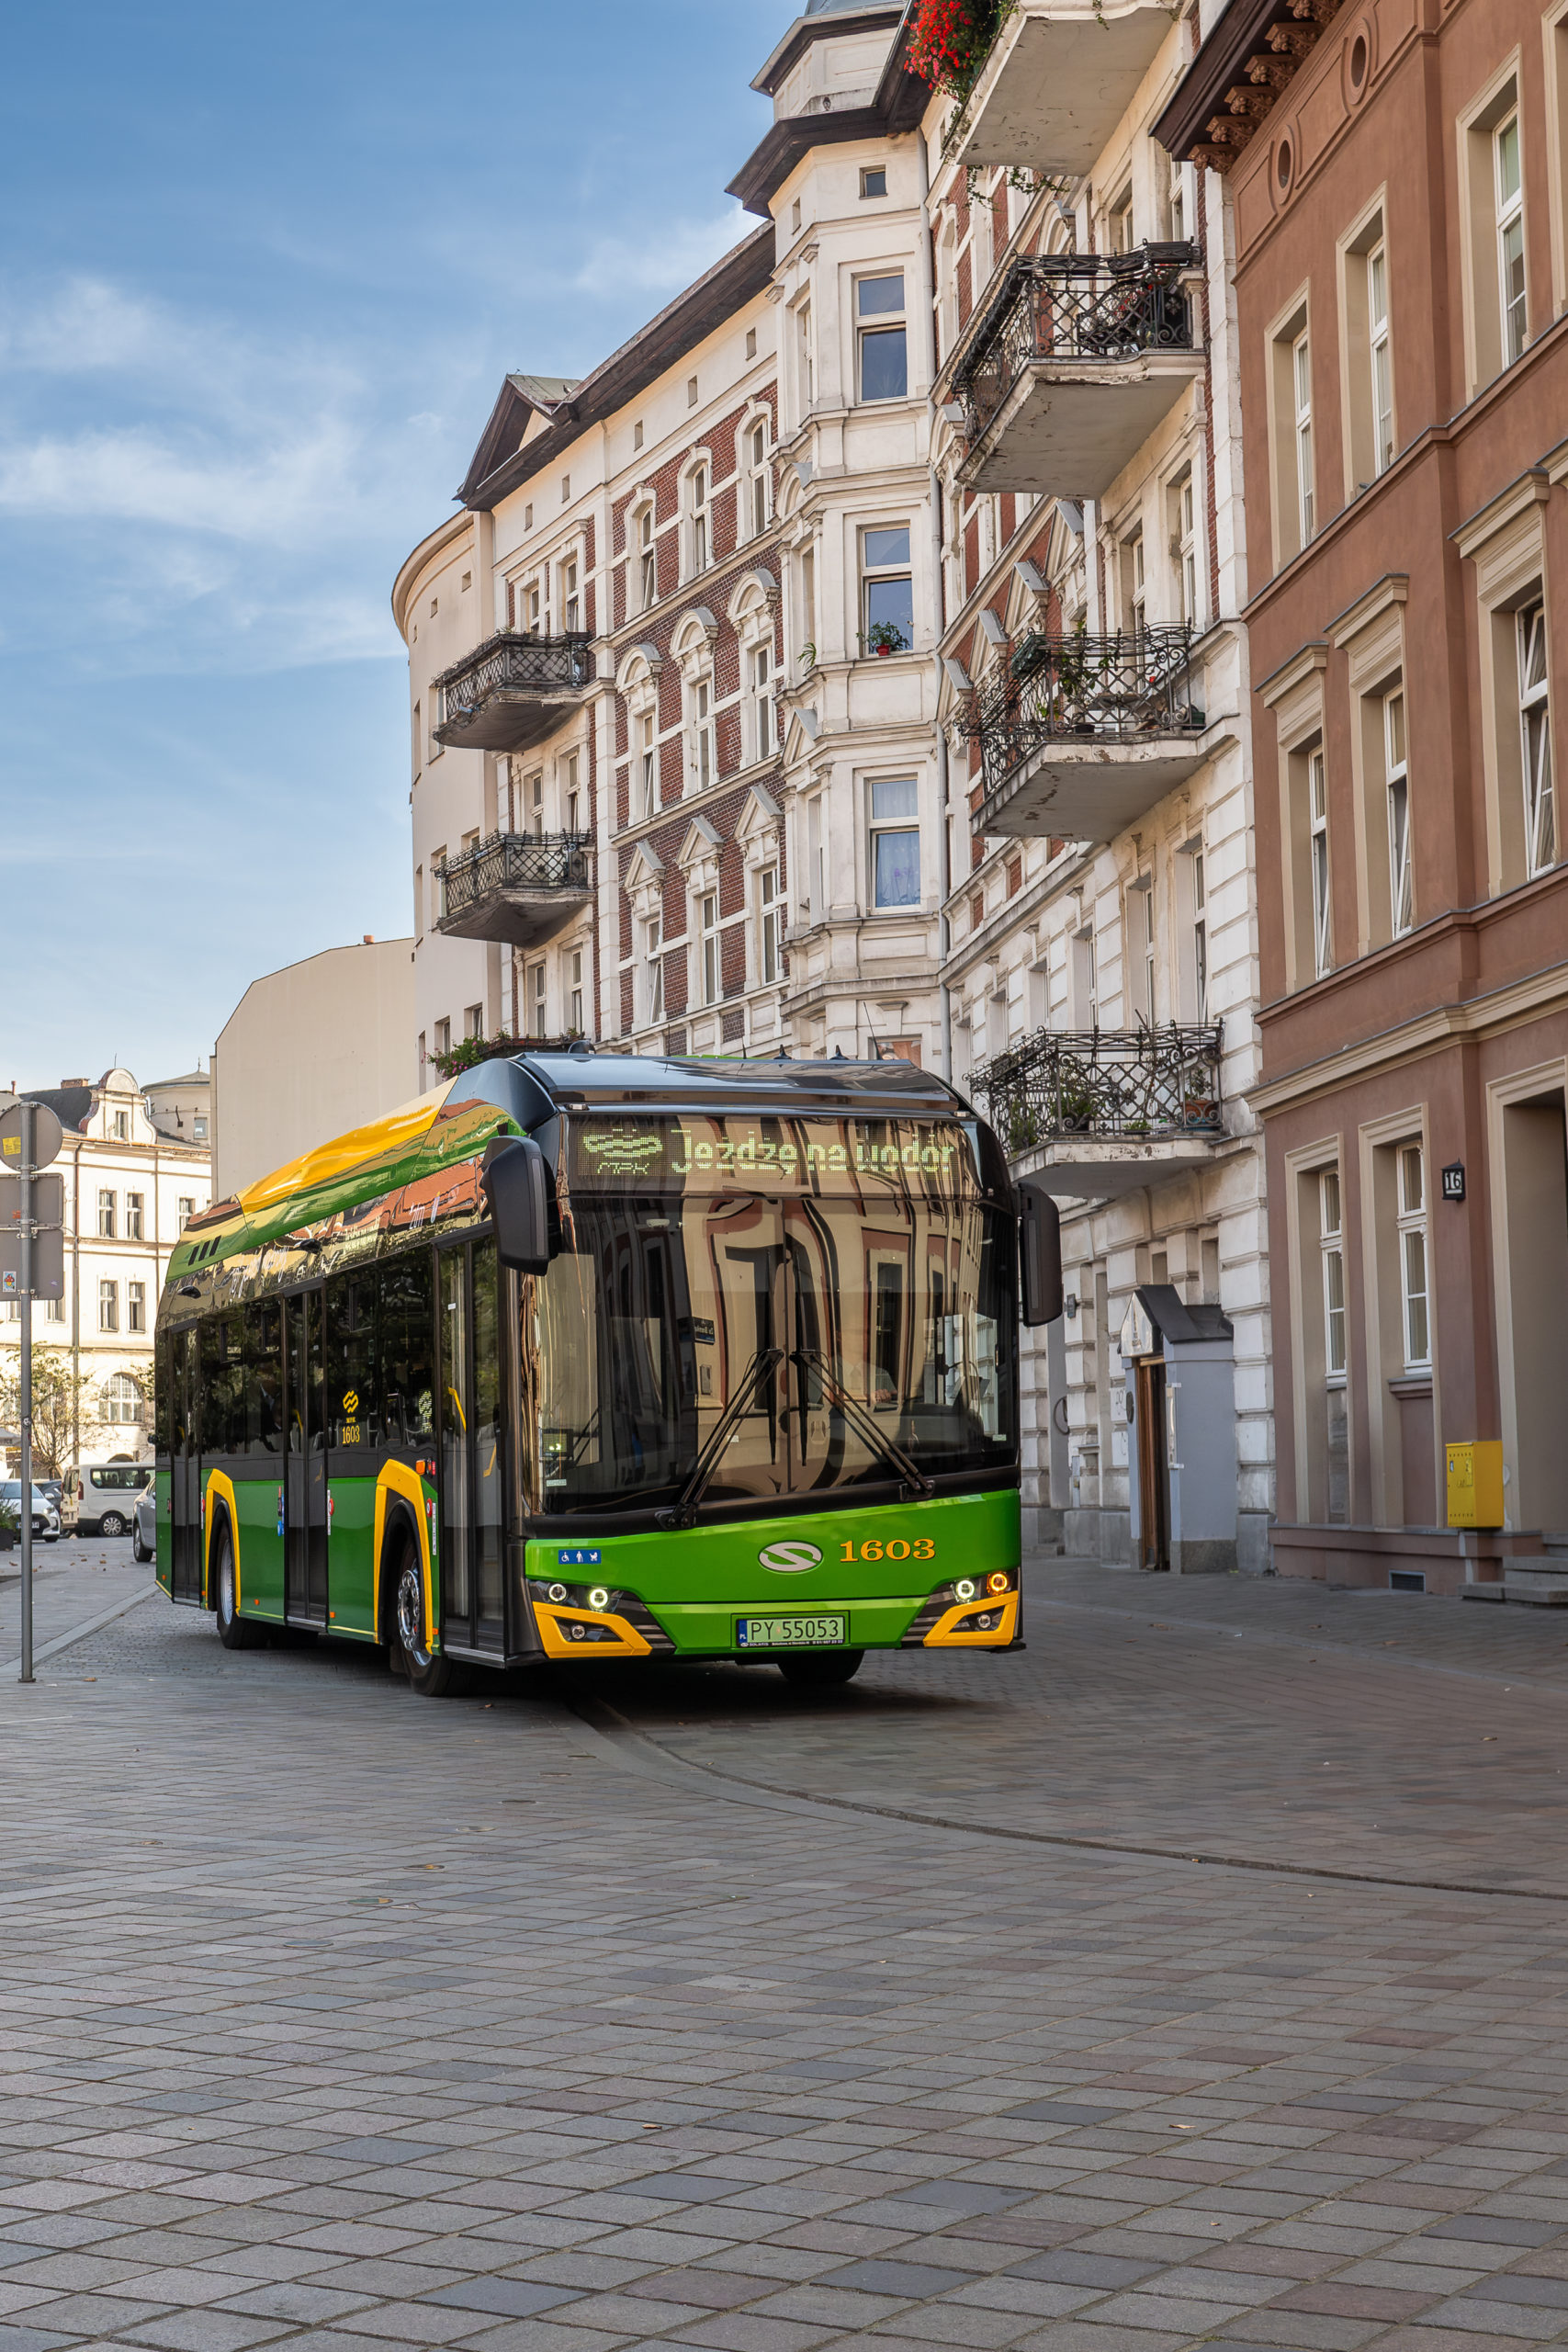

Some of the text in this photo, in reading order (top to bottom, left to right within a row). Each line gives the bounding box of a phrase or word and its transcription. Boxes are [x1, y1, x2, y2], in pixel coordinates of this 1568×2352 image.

[807, 1144, 847, 1170] na
[1447, 1172, 1461, 1190] 16
[342, 1425, 360, 1444] 1603
[840, 1539, 935, 1563] 1603
[751, 1619, 839, 1640] PY 55053
